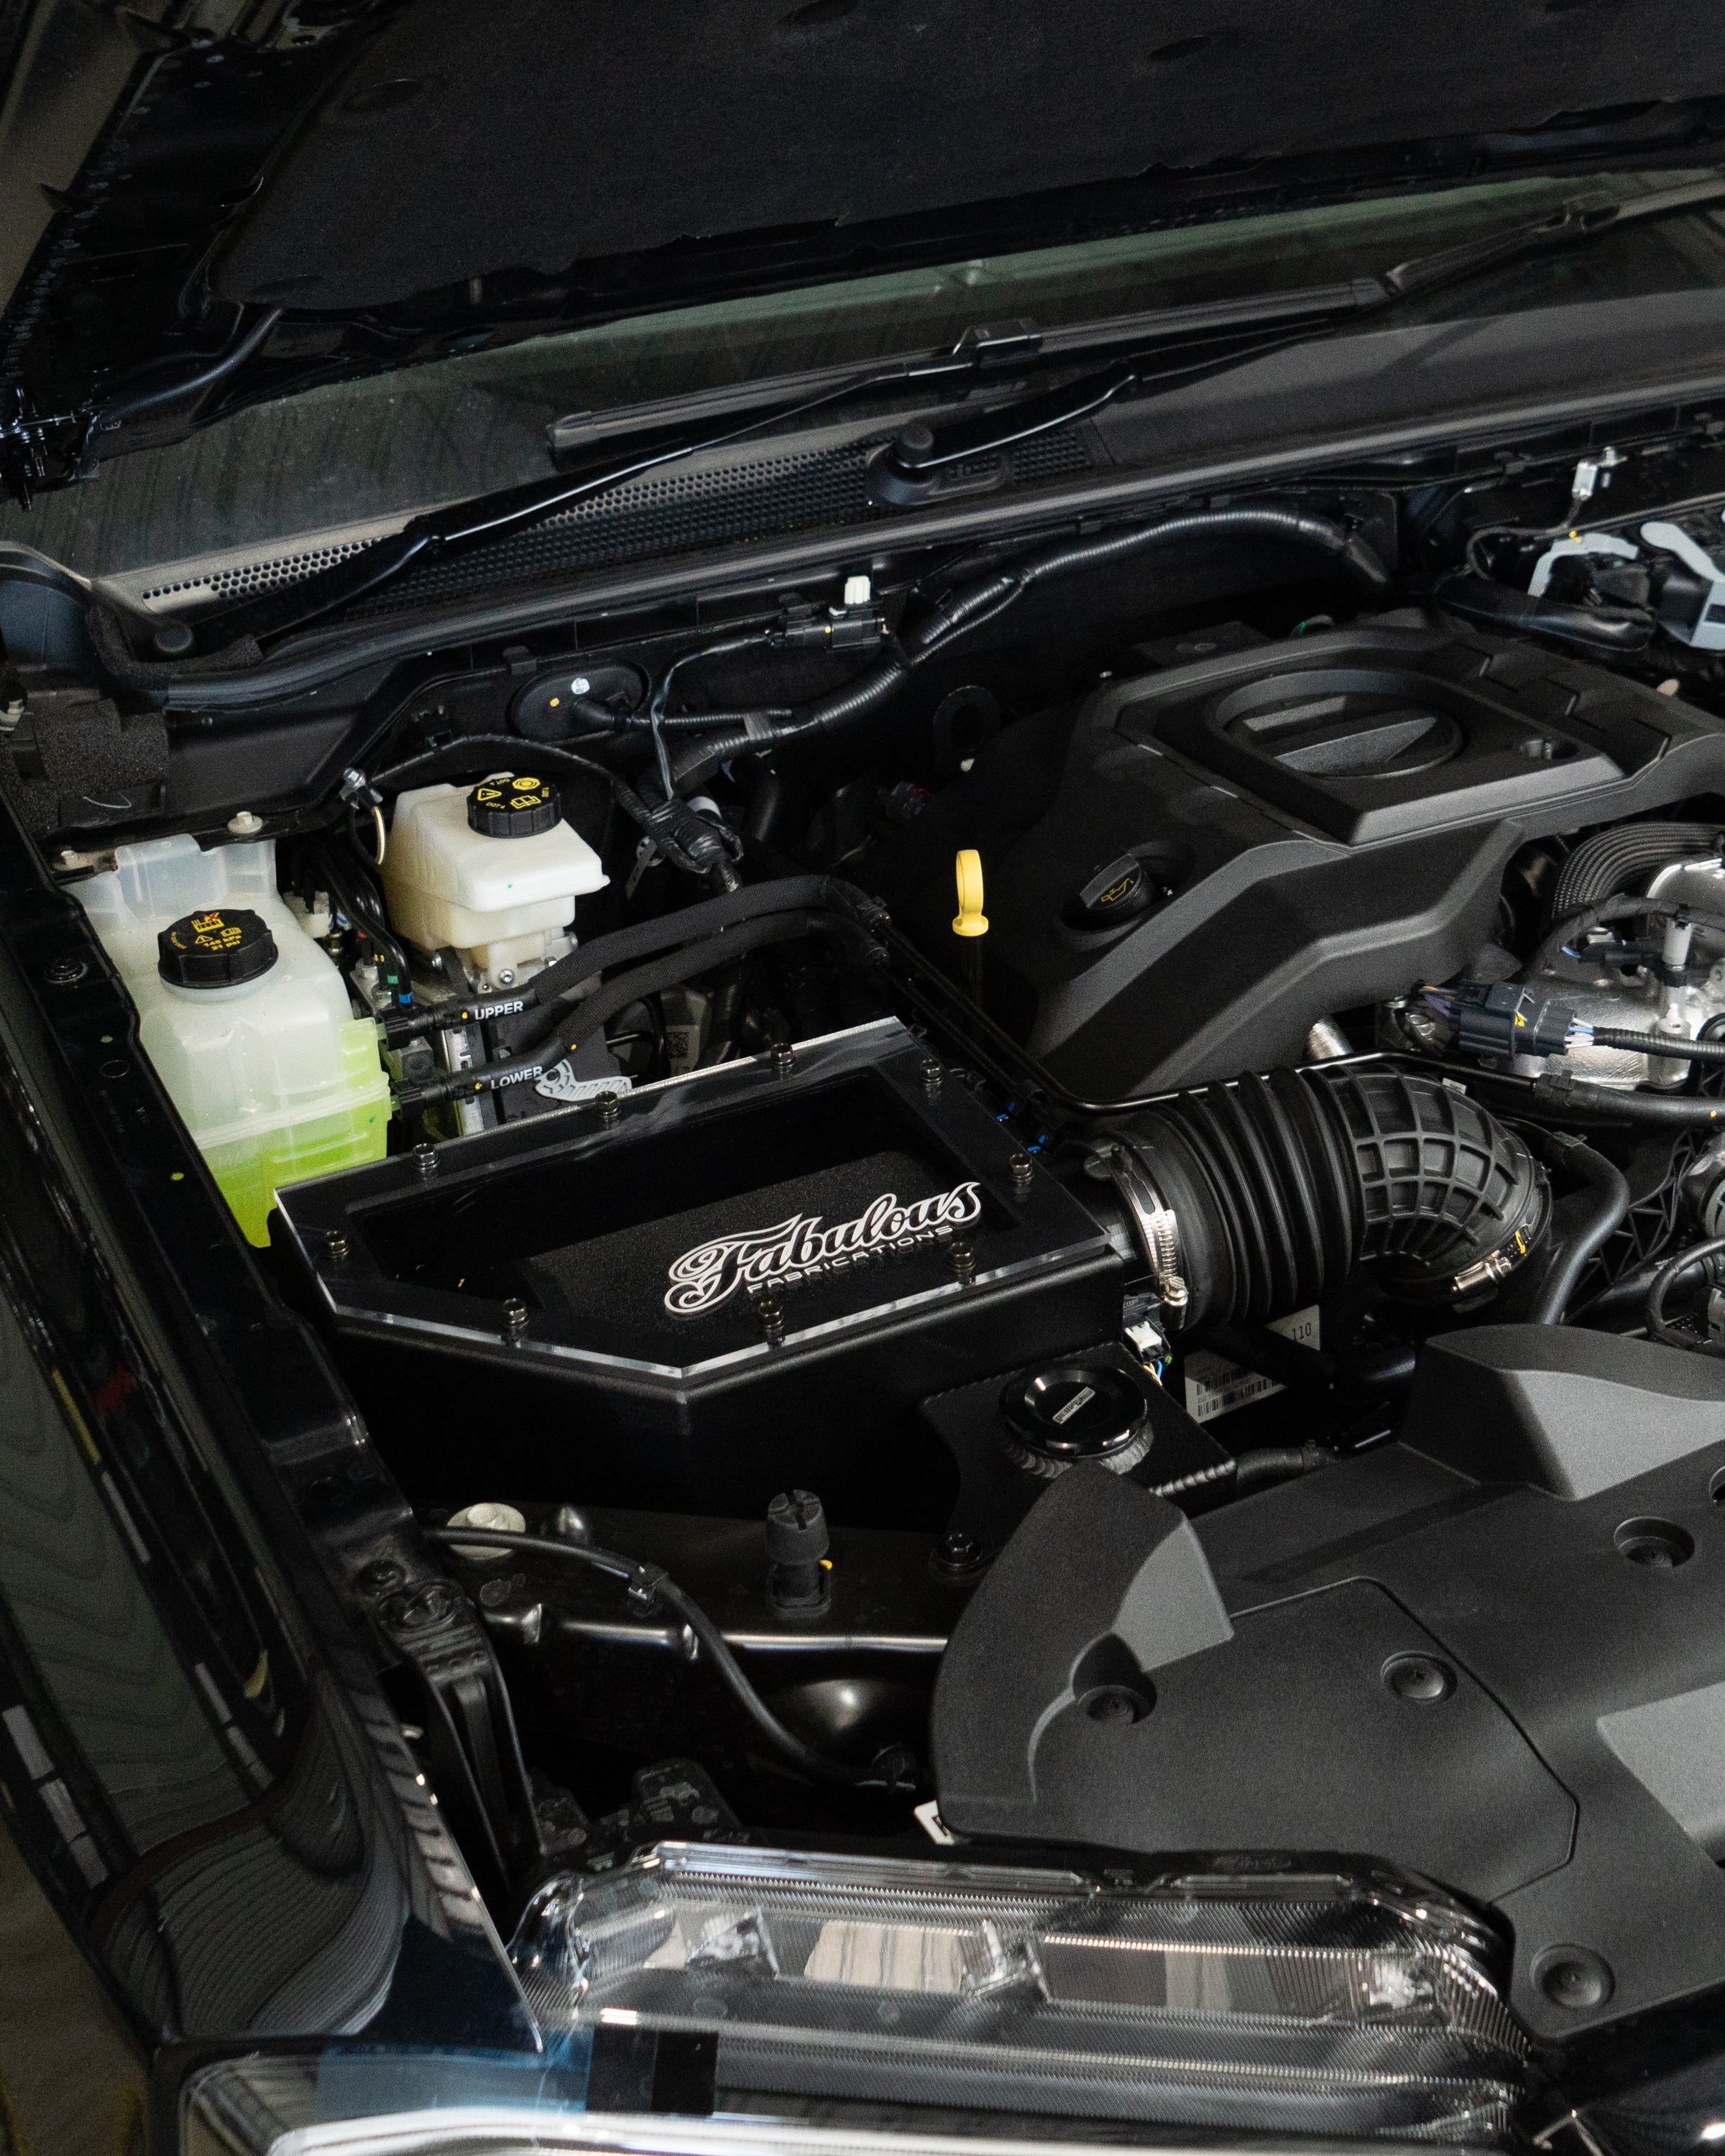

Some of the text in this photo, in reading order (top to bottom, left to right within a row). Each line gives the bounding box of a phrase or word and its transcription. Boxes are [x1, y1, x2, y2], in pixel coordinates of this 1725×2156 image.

[474, 1000, 524, 1021] UPPER
[491, 1066, 543, 1089] LOWER
[664, 1181, 981, 1314] Fabulous
[747, 1225, 953, 1294] FABRICATIONS
[1292, 1322, 1312, 1341] 110
